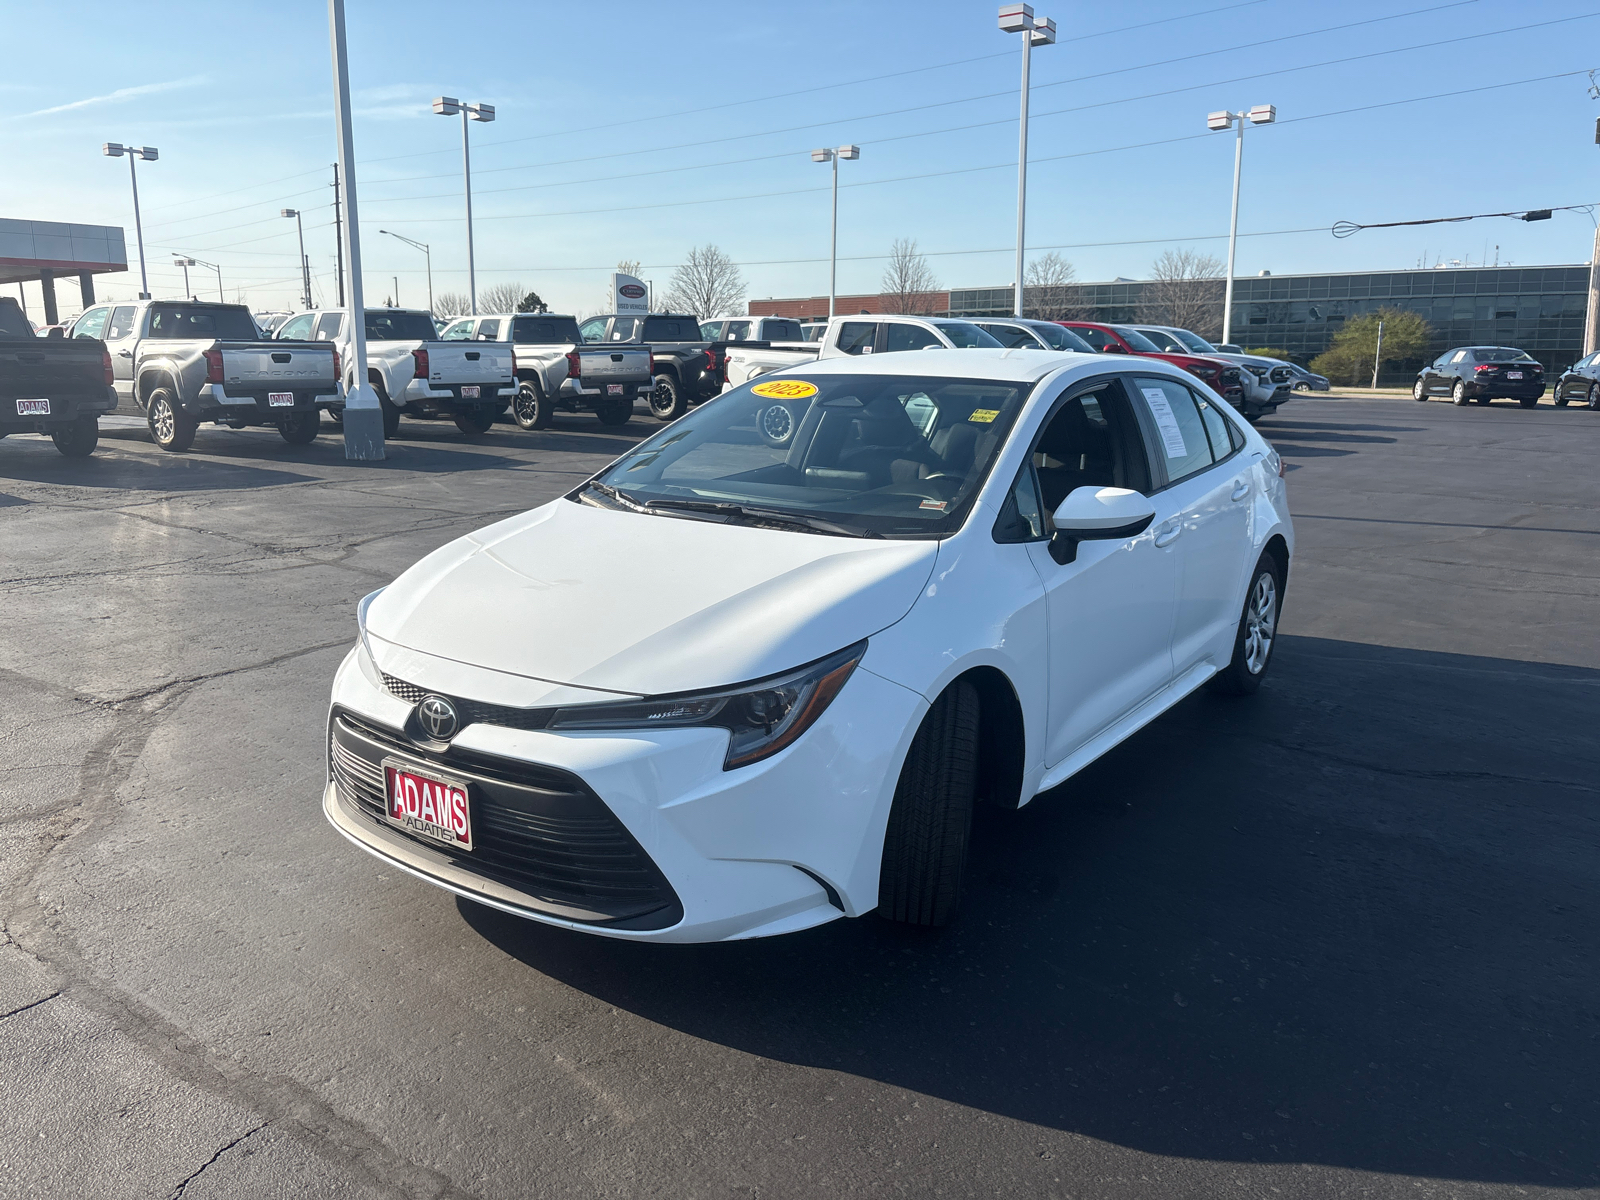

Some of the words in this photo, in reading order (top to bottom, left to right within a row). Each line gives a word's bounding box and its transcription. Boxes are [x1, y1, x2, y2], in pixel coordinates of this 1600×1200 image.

[463, 388, 479, 398] ADAMS
[608, 385, 622, 394] ADAMS
[757, 383, 811, 396] 2023
[271, 394, 292, 404] ADAMS
[20, 401, 47, 412] ADAMS
[394, 773, 467, 836] ADAMS
[406, 817, 453, 842] ADAMS
